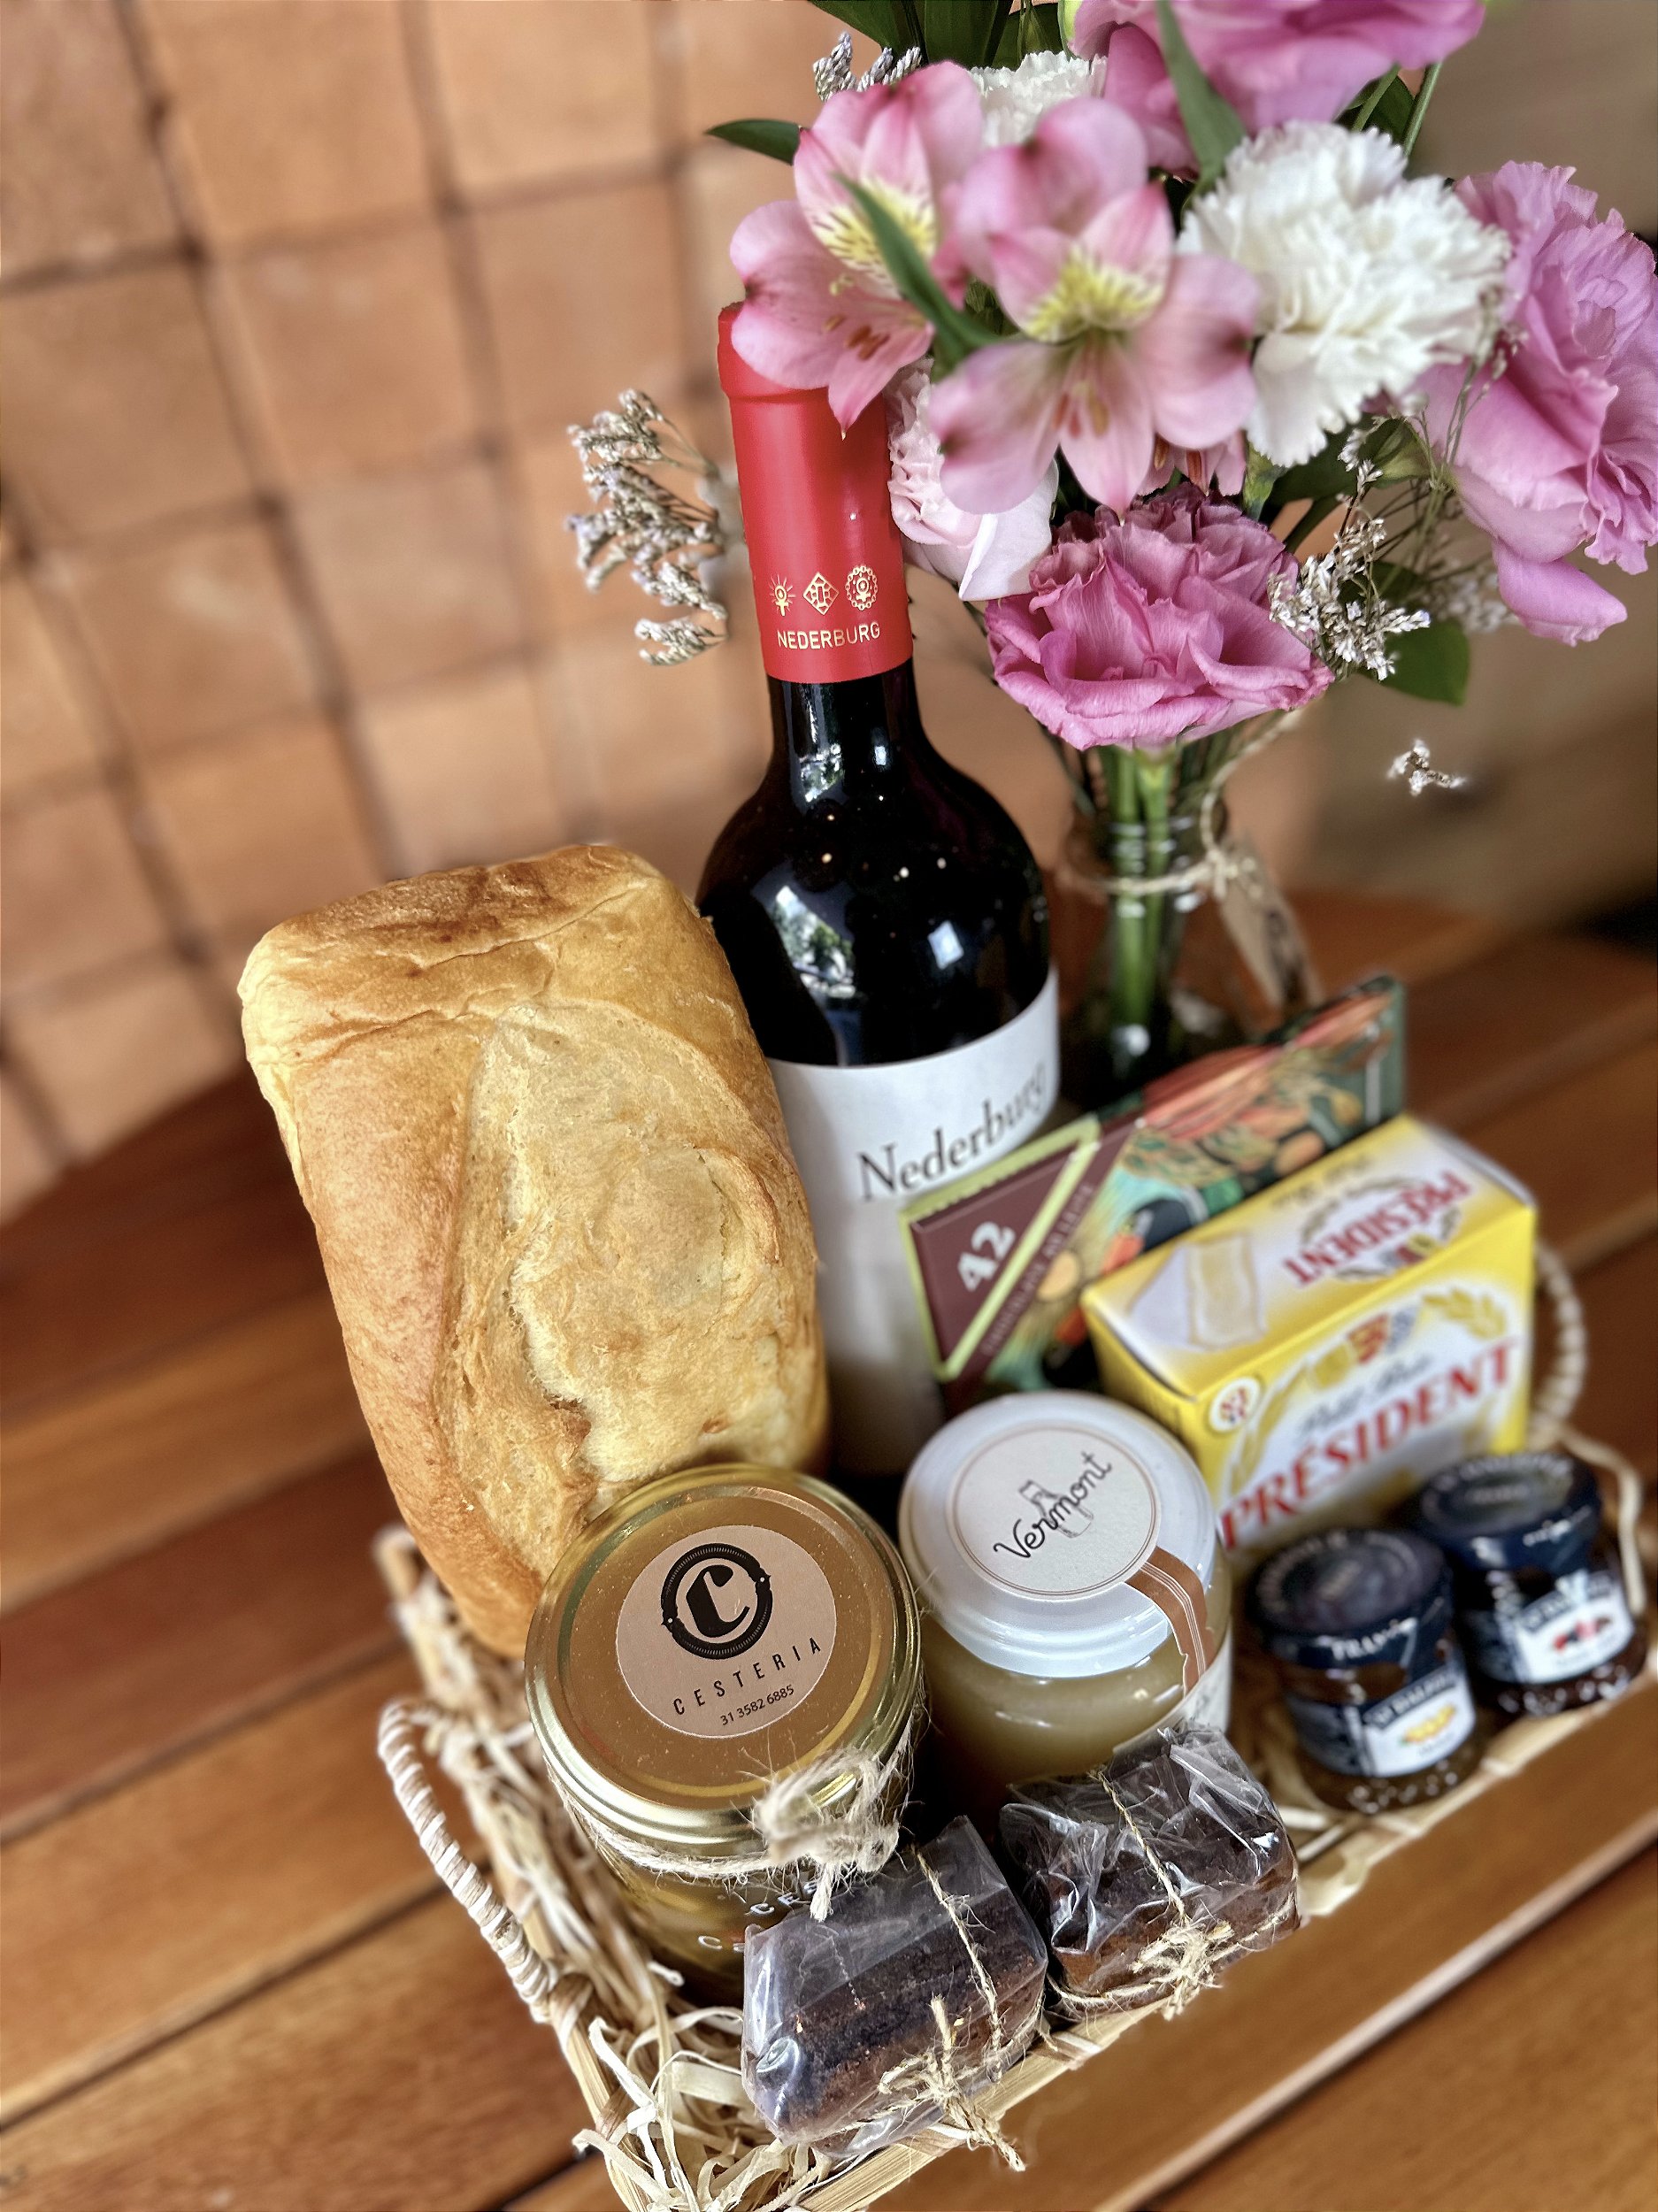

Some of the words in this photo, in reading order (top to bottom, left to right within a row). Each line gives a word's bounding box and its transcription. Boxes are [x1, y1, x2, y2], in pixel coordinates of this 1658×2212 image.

[777, 621, 880, 649] NEDERBURG
[858, 1061, 1046, 1202] Nederburg
[957, 1221, 1016, 1291] 42
[1219, 1338, 1518, 1552] PRÉSIDENT
[993, 1451, 1112, 1559] Vermont
[673, 1637, 821, 1716] CESTERIA
[720, 1711, 734, 1725] 31
[736, 1697, 766, 1719] 3582
[766, 1684, 795, 1705] 6885
